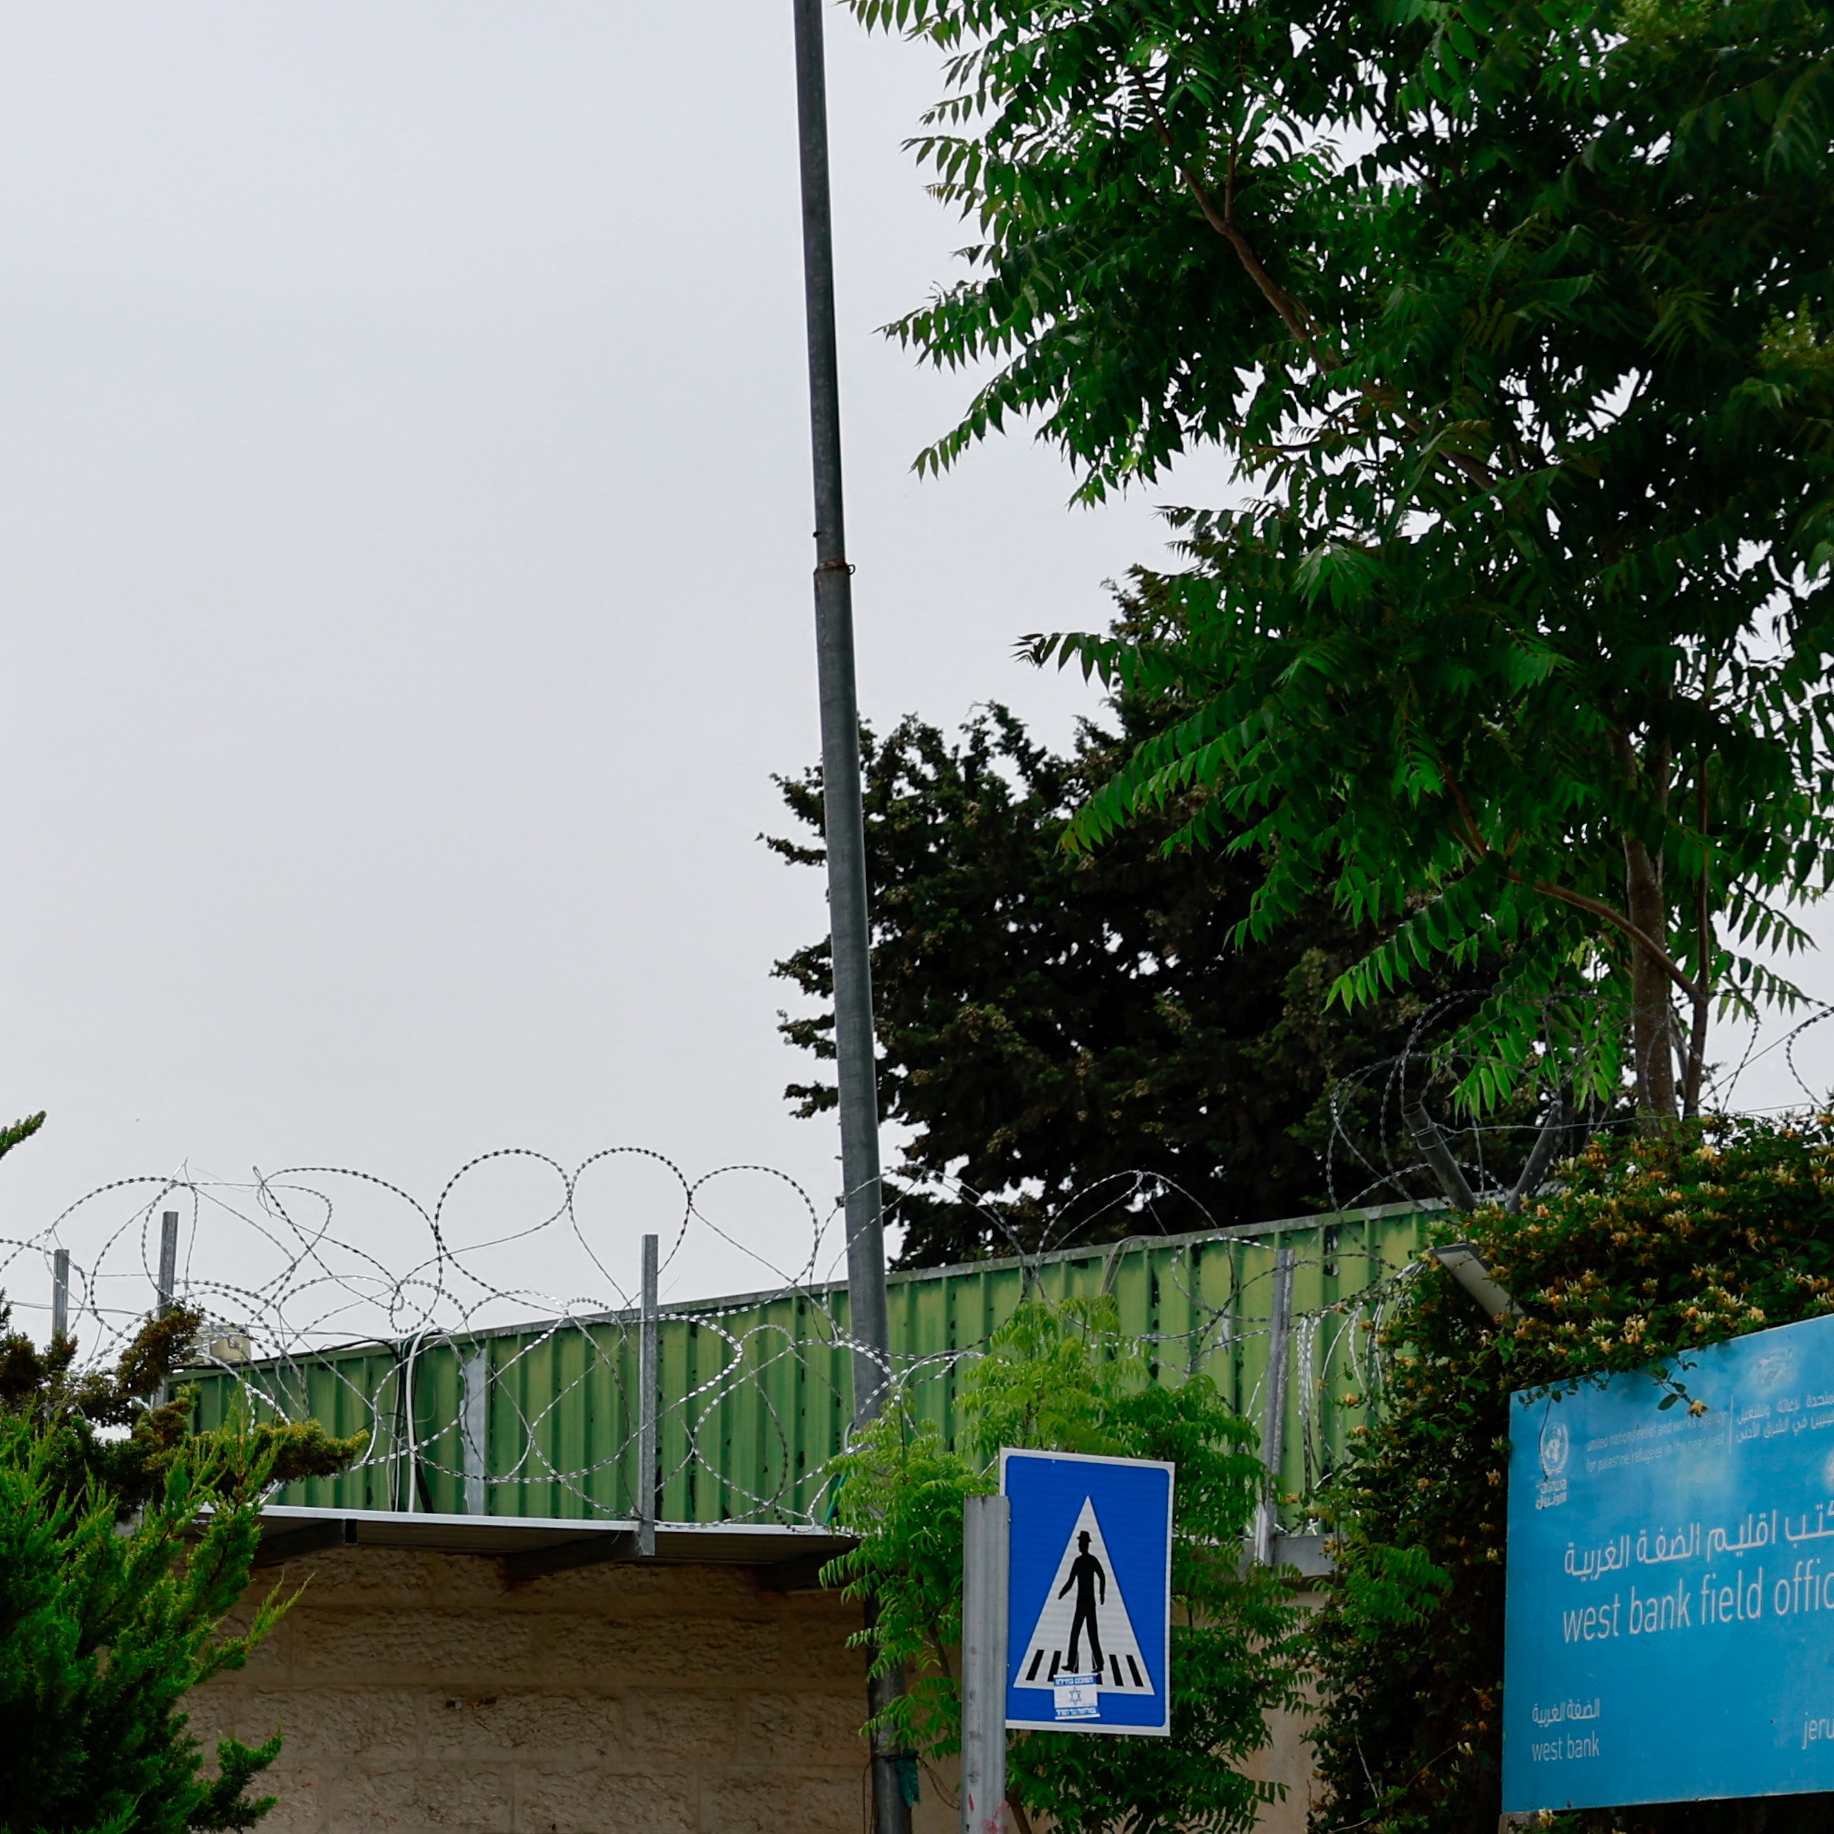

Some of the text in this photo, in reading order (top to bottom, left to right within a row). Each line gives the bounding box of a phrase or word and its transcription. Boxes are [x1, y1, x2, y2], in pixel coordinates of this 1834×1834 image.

[1564, 1534, 1630, 1581] الغربية
[1637, 1522, 1700, 1564] الضفة
[1563, 1593, 1620, 1643] west
[1629, 1578, 1691, 1635] bank
[1701, 1566, 1762, 1625] field
[1532, 1698, 1600, 1728] الضفة الغربية
[1531, 1730, 1600, 1761] west bank
